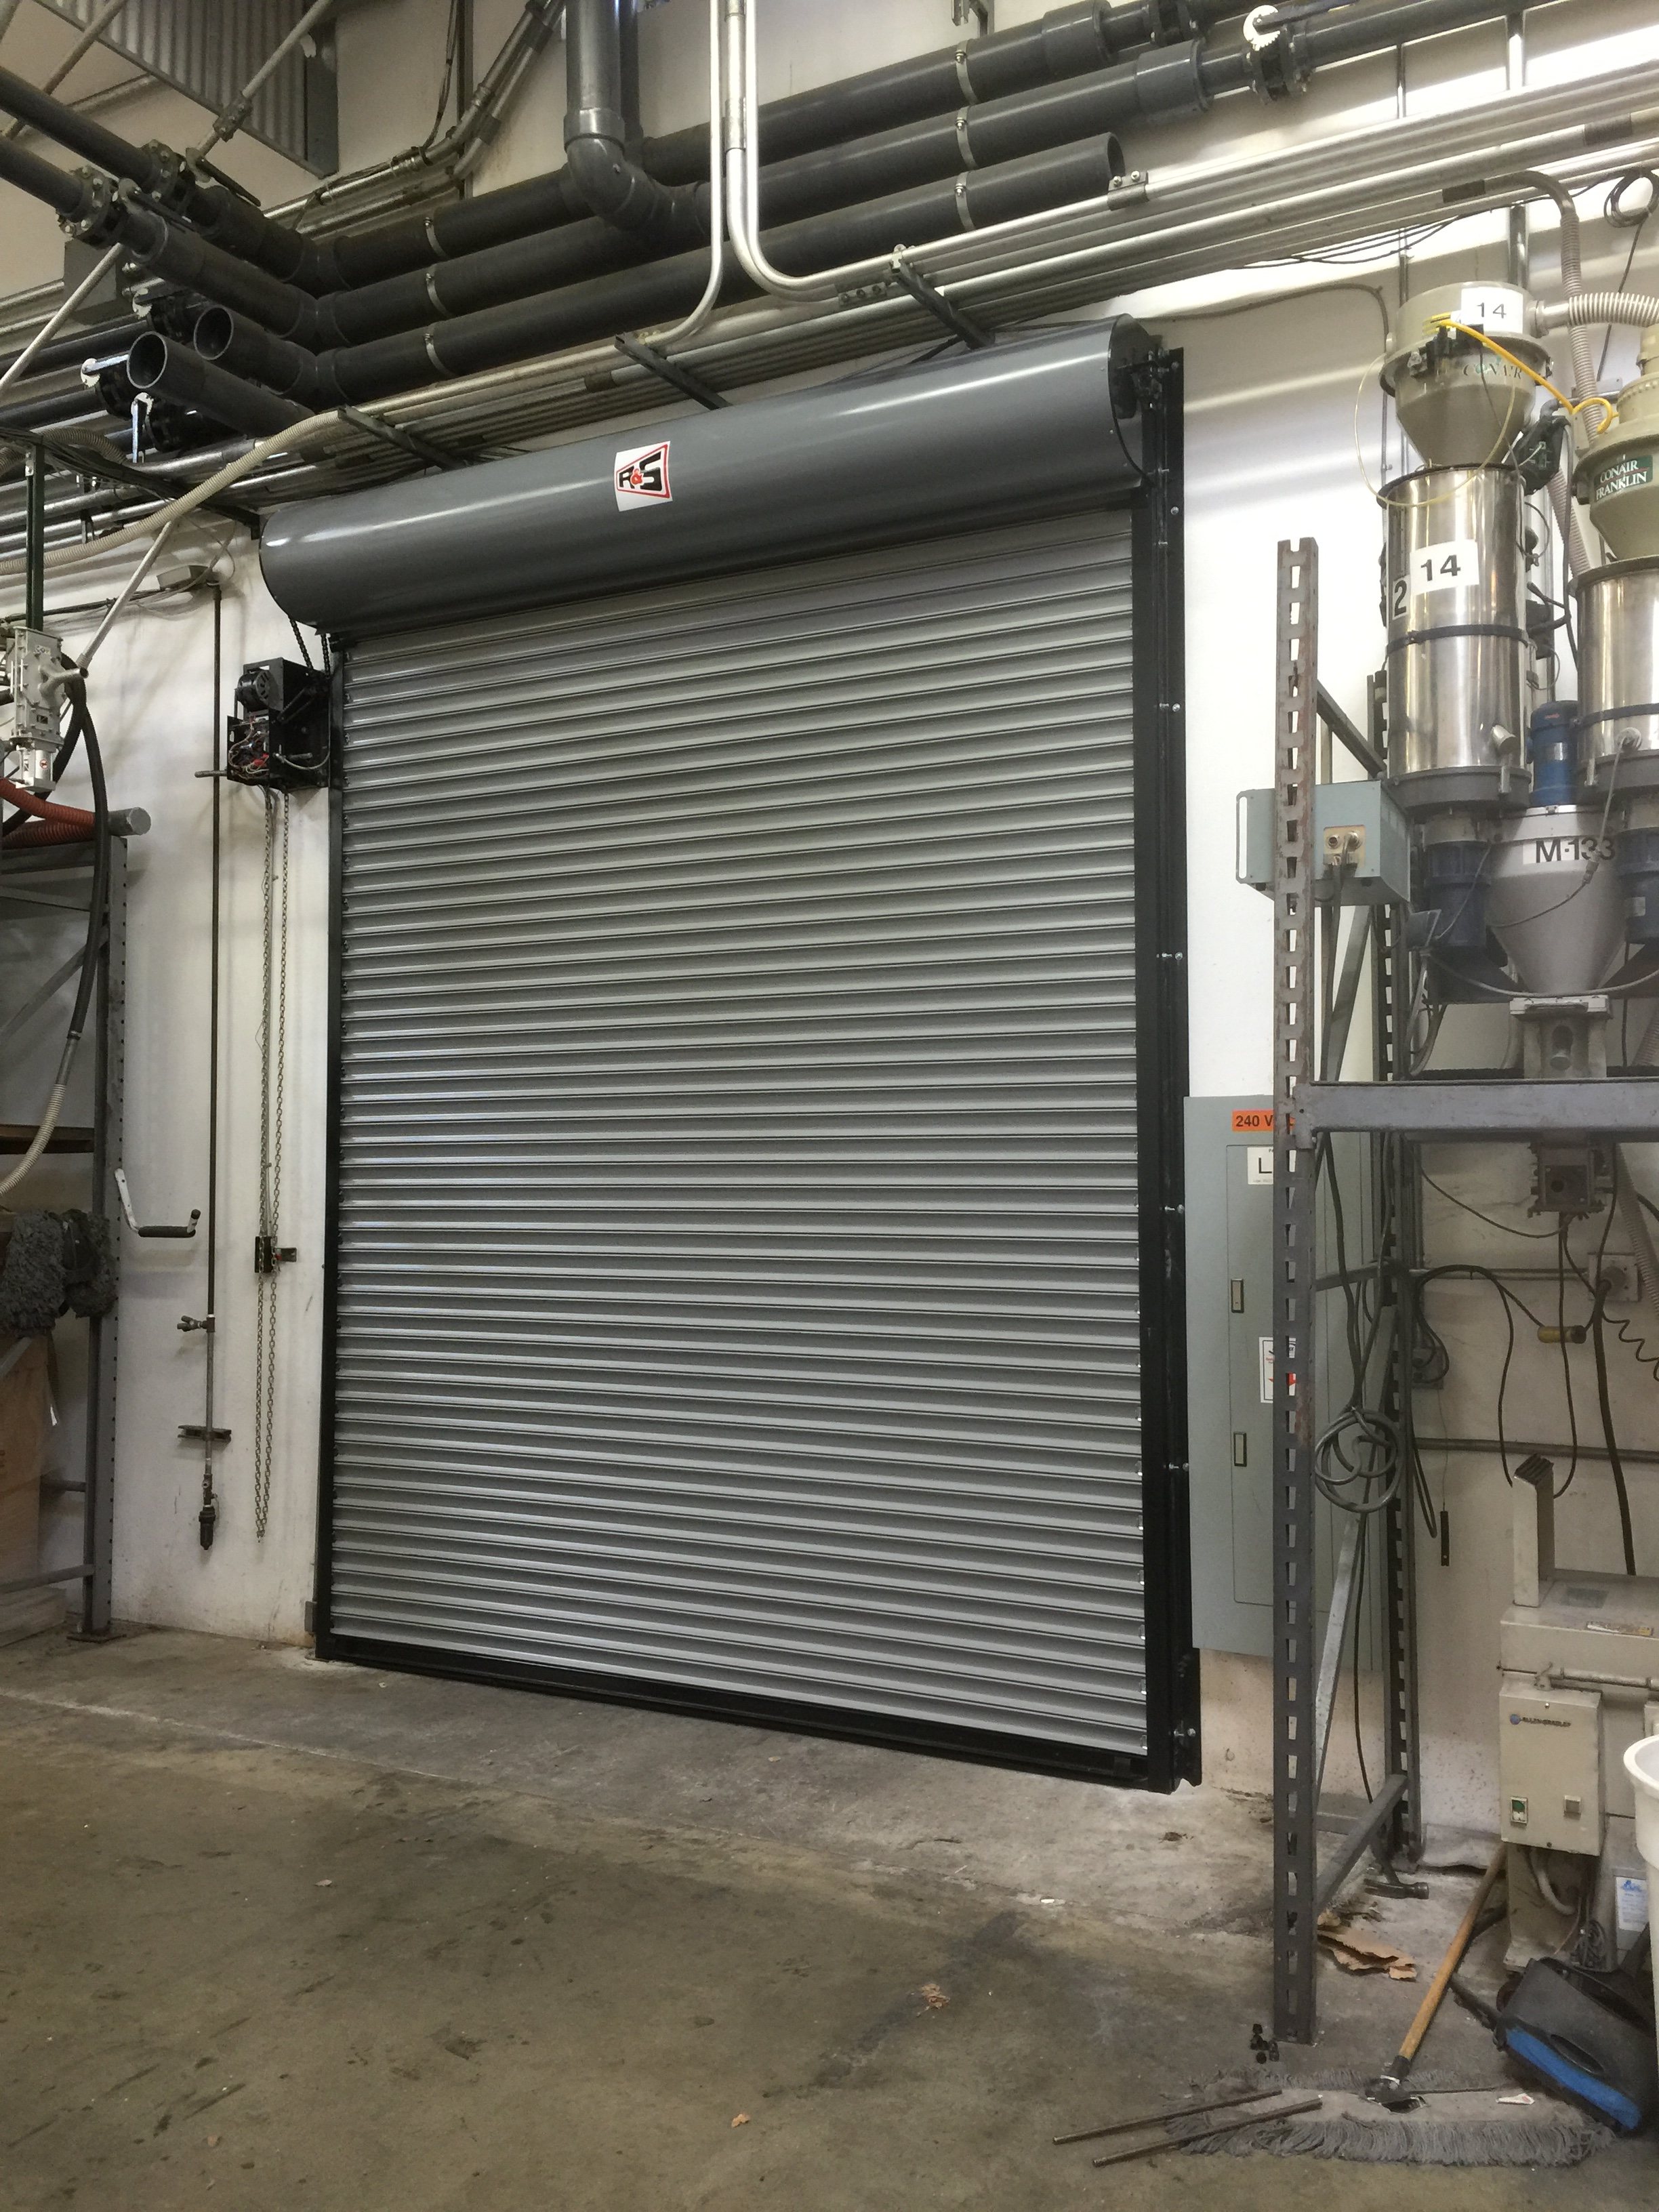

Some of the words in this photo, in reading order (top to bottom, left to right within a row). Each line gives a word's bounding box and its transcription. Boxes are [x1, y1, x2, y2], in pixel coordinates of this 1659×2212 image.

[1476, 302, 1507, 319] 14
[619, 451, 663, 492] R&S
[1600, 459, 1639, 483] CONAIR
[1596, 471, 1647, 500] FRANKLIN
[1420, 554, 1461, 581] 14
[1394, 579, 1408, 617] 2
[1535, 836, 1616, 863] M-133
[1235, 1115, 1261, 1127] 240
